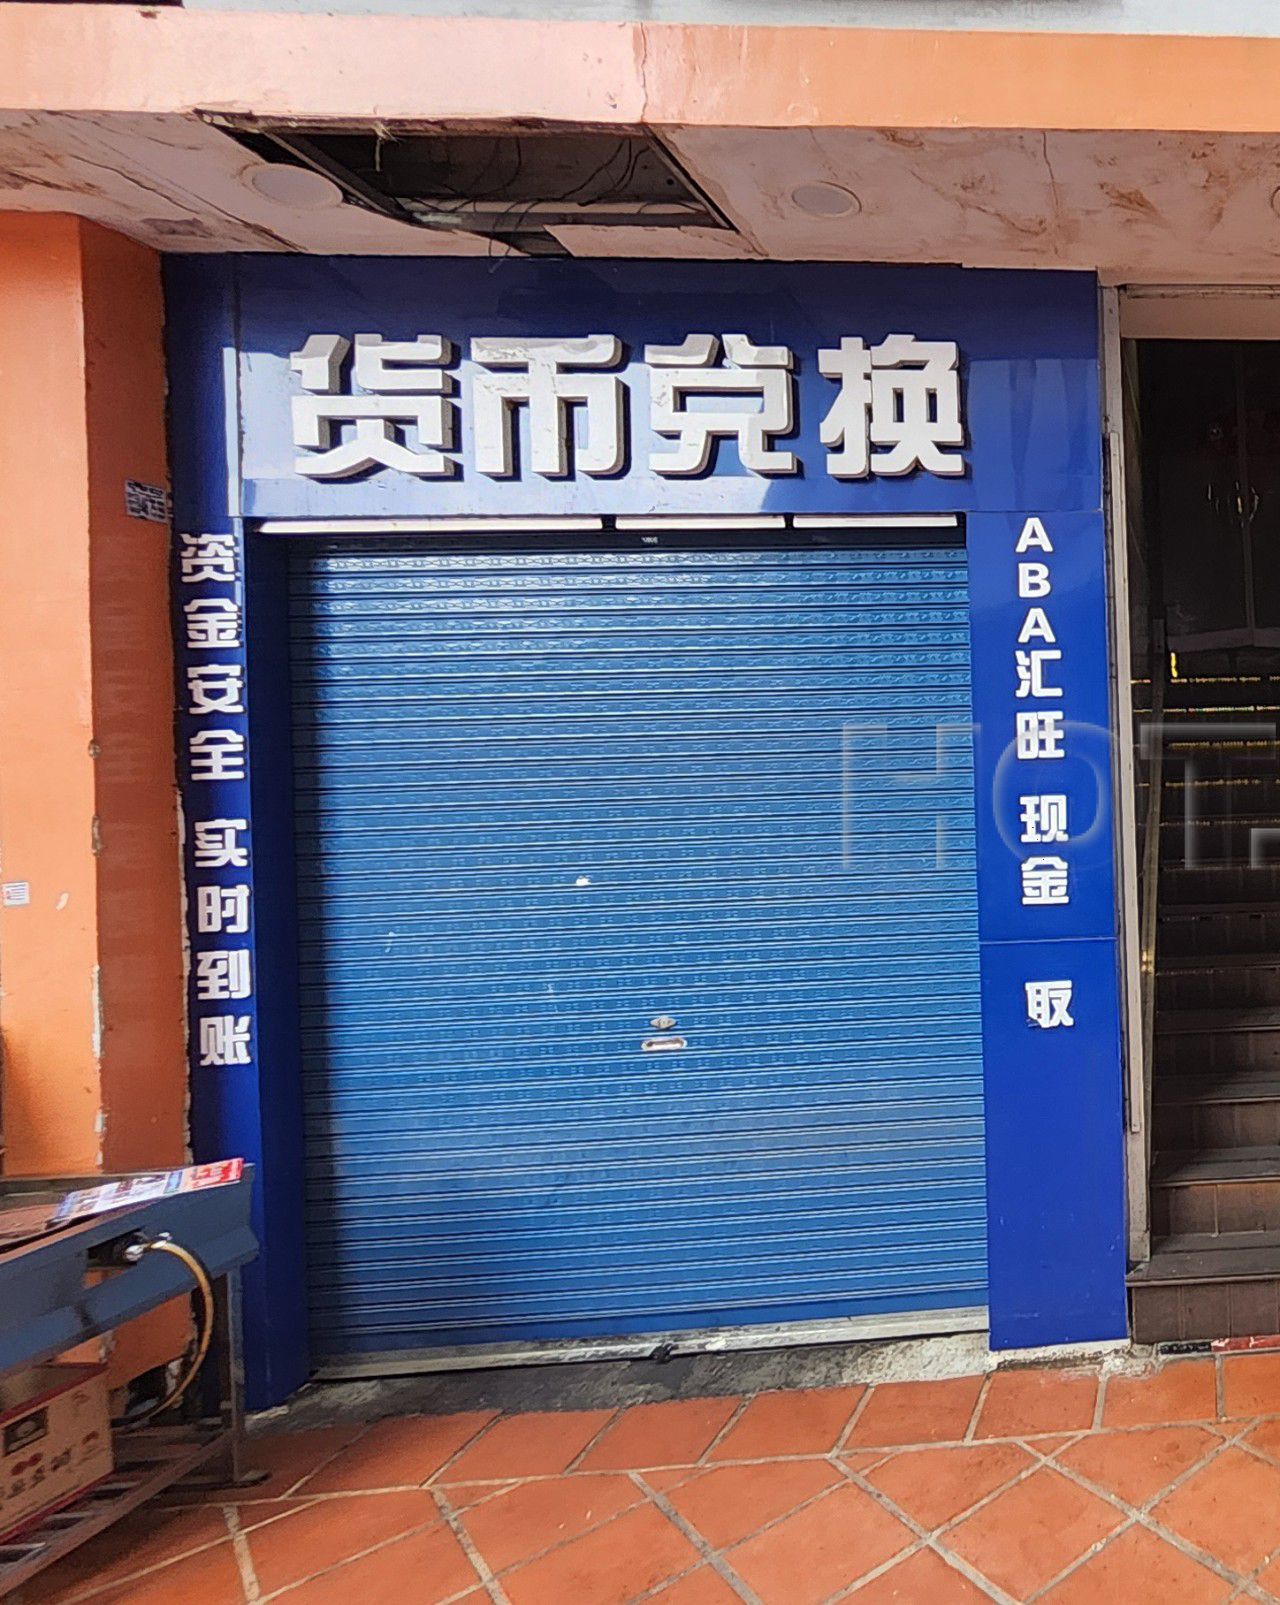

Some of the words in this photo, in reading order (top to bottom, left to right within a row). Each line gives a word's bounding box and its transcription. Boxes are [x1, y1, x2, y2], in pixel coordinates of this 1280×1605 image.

[290, 333, 969, 480] 货币兑换
[178, 532, 246, 782] 资金安全
[194, 818, 252, 1067] 实时到账
